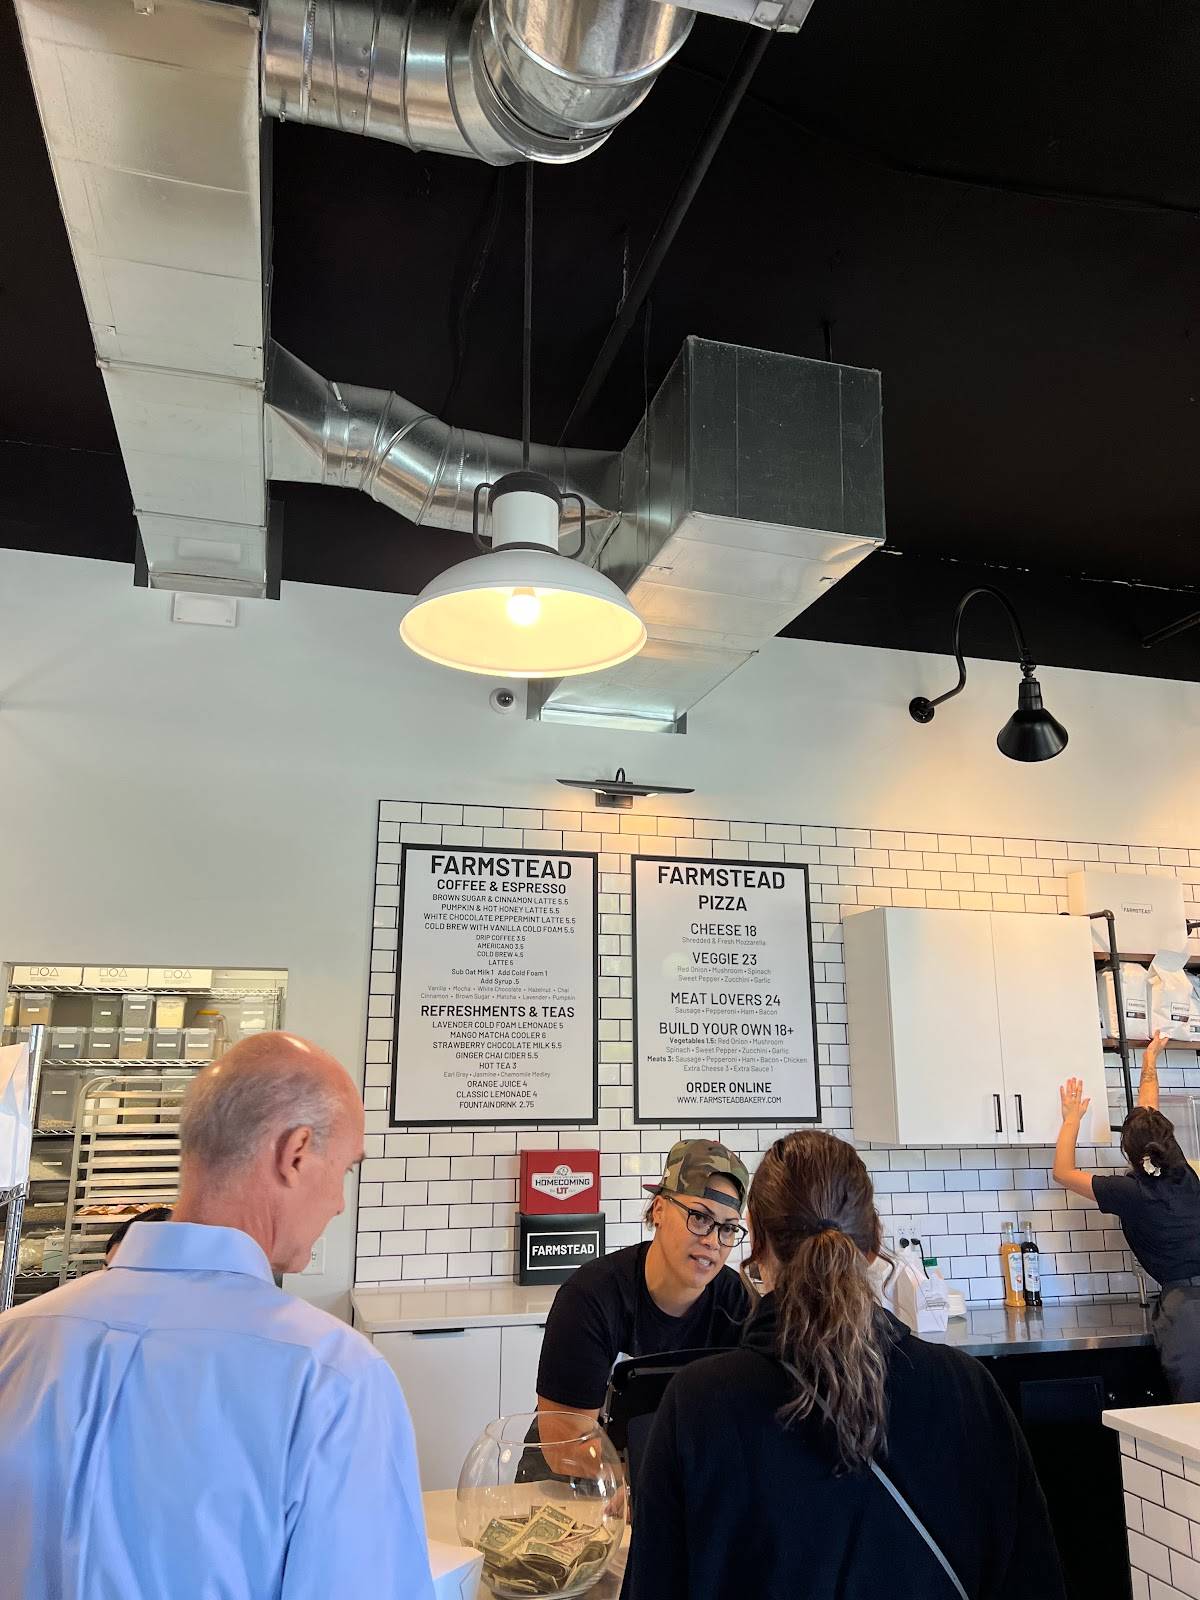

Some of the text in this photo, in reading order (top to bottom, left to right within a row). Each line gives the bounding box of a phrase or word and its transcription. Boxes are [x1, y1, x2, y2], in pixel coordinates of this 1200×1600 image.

[431, 855, 572, 879] FARMSTEAD
[658, 866, 785, 889] FARMSTEAD
[437, 879, 566, 894] COFFEE & ESPRESSO
[432, 893, 460, 901] BROWN
[495, 896, 532, 904] CINNAMON
[534, 897, 556, 905] LATTE
[558, 898, 569, 906] 5.5
[699, 895, 747, 911] PIZZA
[499, 905, 523, 913] HONEY
[449, 914, 493, 922] CHOCOLATE
[494, 915, 540, 923] PEPPERMINT
[424, 922, 445, 930] COLD
[522, 925, 542, 933] COLD
[564, 926, 575, 934] 5.5
[691, 923, 757, 937] CHEESE 18
[477, 942, 514, 950] AMERICANO
[692, 952, 757, 966] VEGGIE 23
[747, 967, 771, 975] Spinach
[494, 978, 513, 986] Syrup
[698, 975, 720, 983] Pepper
[671, 992, 781, 1006] MEAT LOVERS 24
[421, 1005, 575, 1018] REFRESHMENTS & TEAS
[474, 1021, 495, 1029] COLD
[660, 1022, 794, 1036] BUILD YOUR OWN 18+
[450, 1031, 477, 1039] MANGO
[432, 1041, 485, 1049] STRAWBERRY
[486, 1041, 531, 1049] CHOCOLATE
[532, 1041, 550, 1049] MILK
[669, 1037, 705, 1045] Vegetables
[467, 1080, 498, 1088] ORANGE
[686, 1082, 772, 1093] ORDER ONLINE
[459, 1101, 495, 1109] FOUNTAIN
[535, 1178, 590, 1186] HOMECOMING
[532, 1244, 595, 1256] FARMSTEAD
